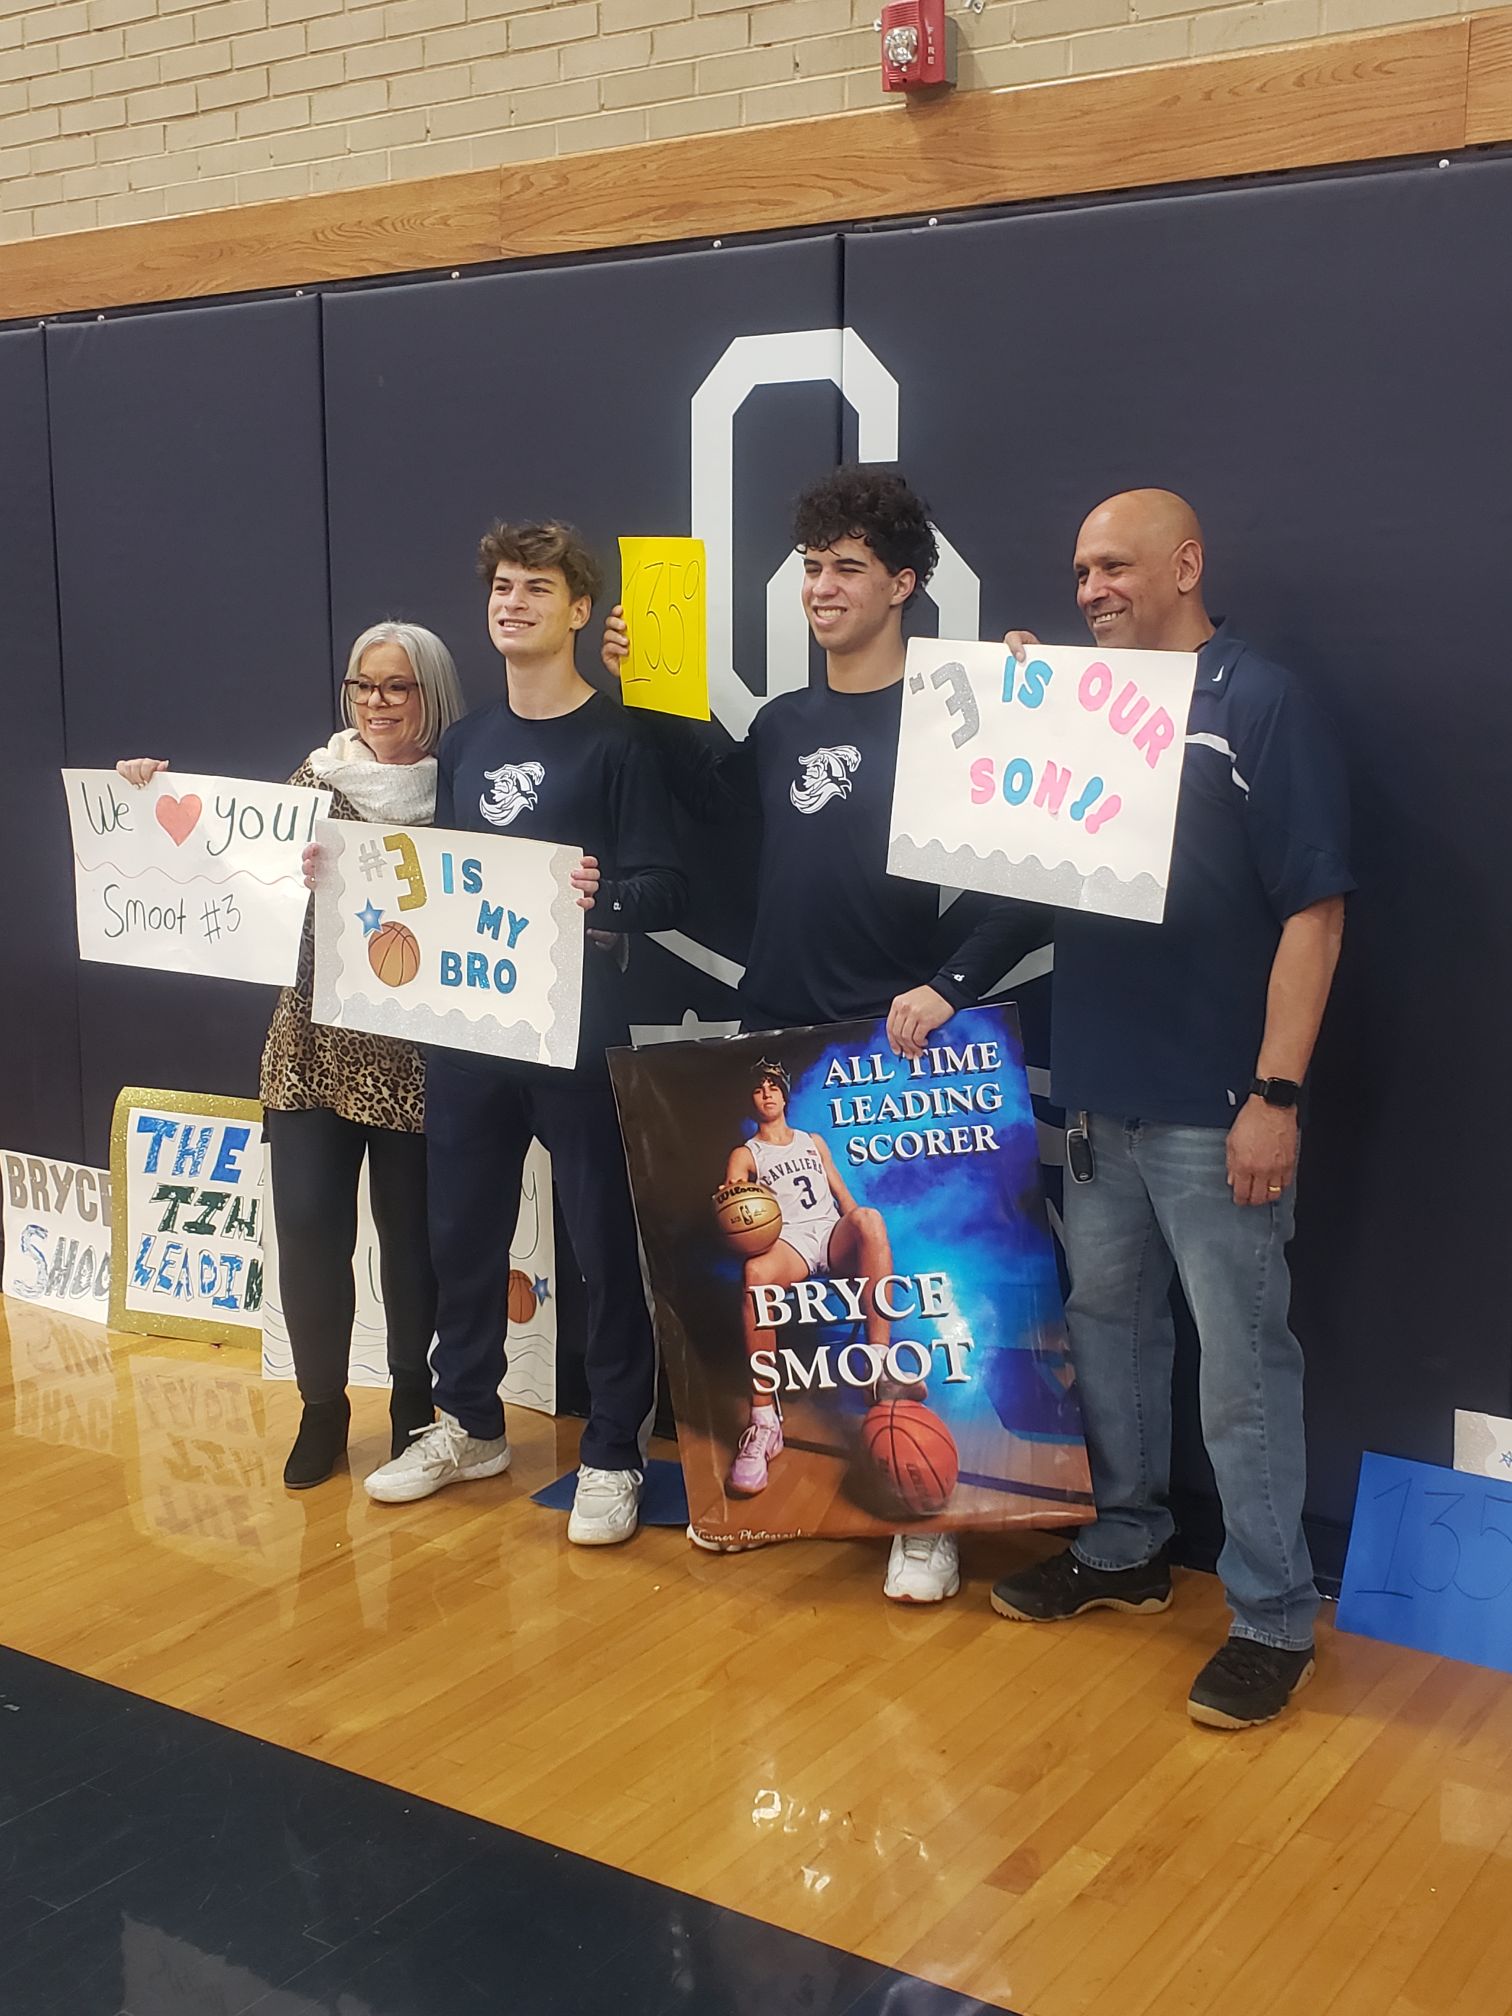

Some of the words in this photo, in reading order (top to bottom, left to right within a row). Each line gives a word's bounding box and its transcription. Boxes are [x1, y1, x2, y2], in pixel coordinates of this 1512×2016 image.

[625, 560, 700, 683] 1359
[1002, 655, 1054, 708] IS
[1078, 661, 1175, 769] OUR
[80, 782, 135, 837] We
[970, 757, 1122, 834] SON!!
[440, 852, 484, 895] IS
[103, 883, 187, 938] Smoot
[199, 895, 243, 943] #3
[476, 899, 530, 950] MY
[439, 950, 517, 995] BRO
[823, 1053, 896, 1088] ALL
[900, 1041, 1003, 1078] TIME
[829, 1083, 1004, 1127] LEADING
[136, 1115, 251, 1184] THE
[762, 1157, 823, 1187] CAVALIERS
[848, 1125, 1001, 1165] SCORER
[149, 1183, 263, 1246] TIM
[793, 1175, 818, 1210] 3
[749, 1272, 950, 1329] BRYCE
[750, 1340, 975, 1395] SMOOT
